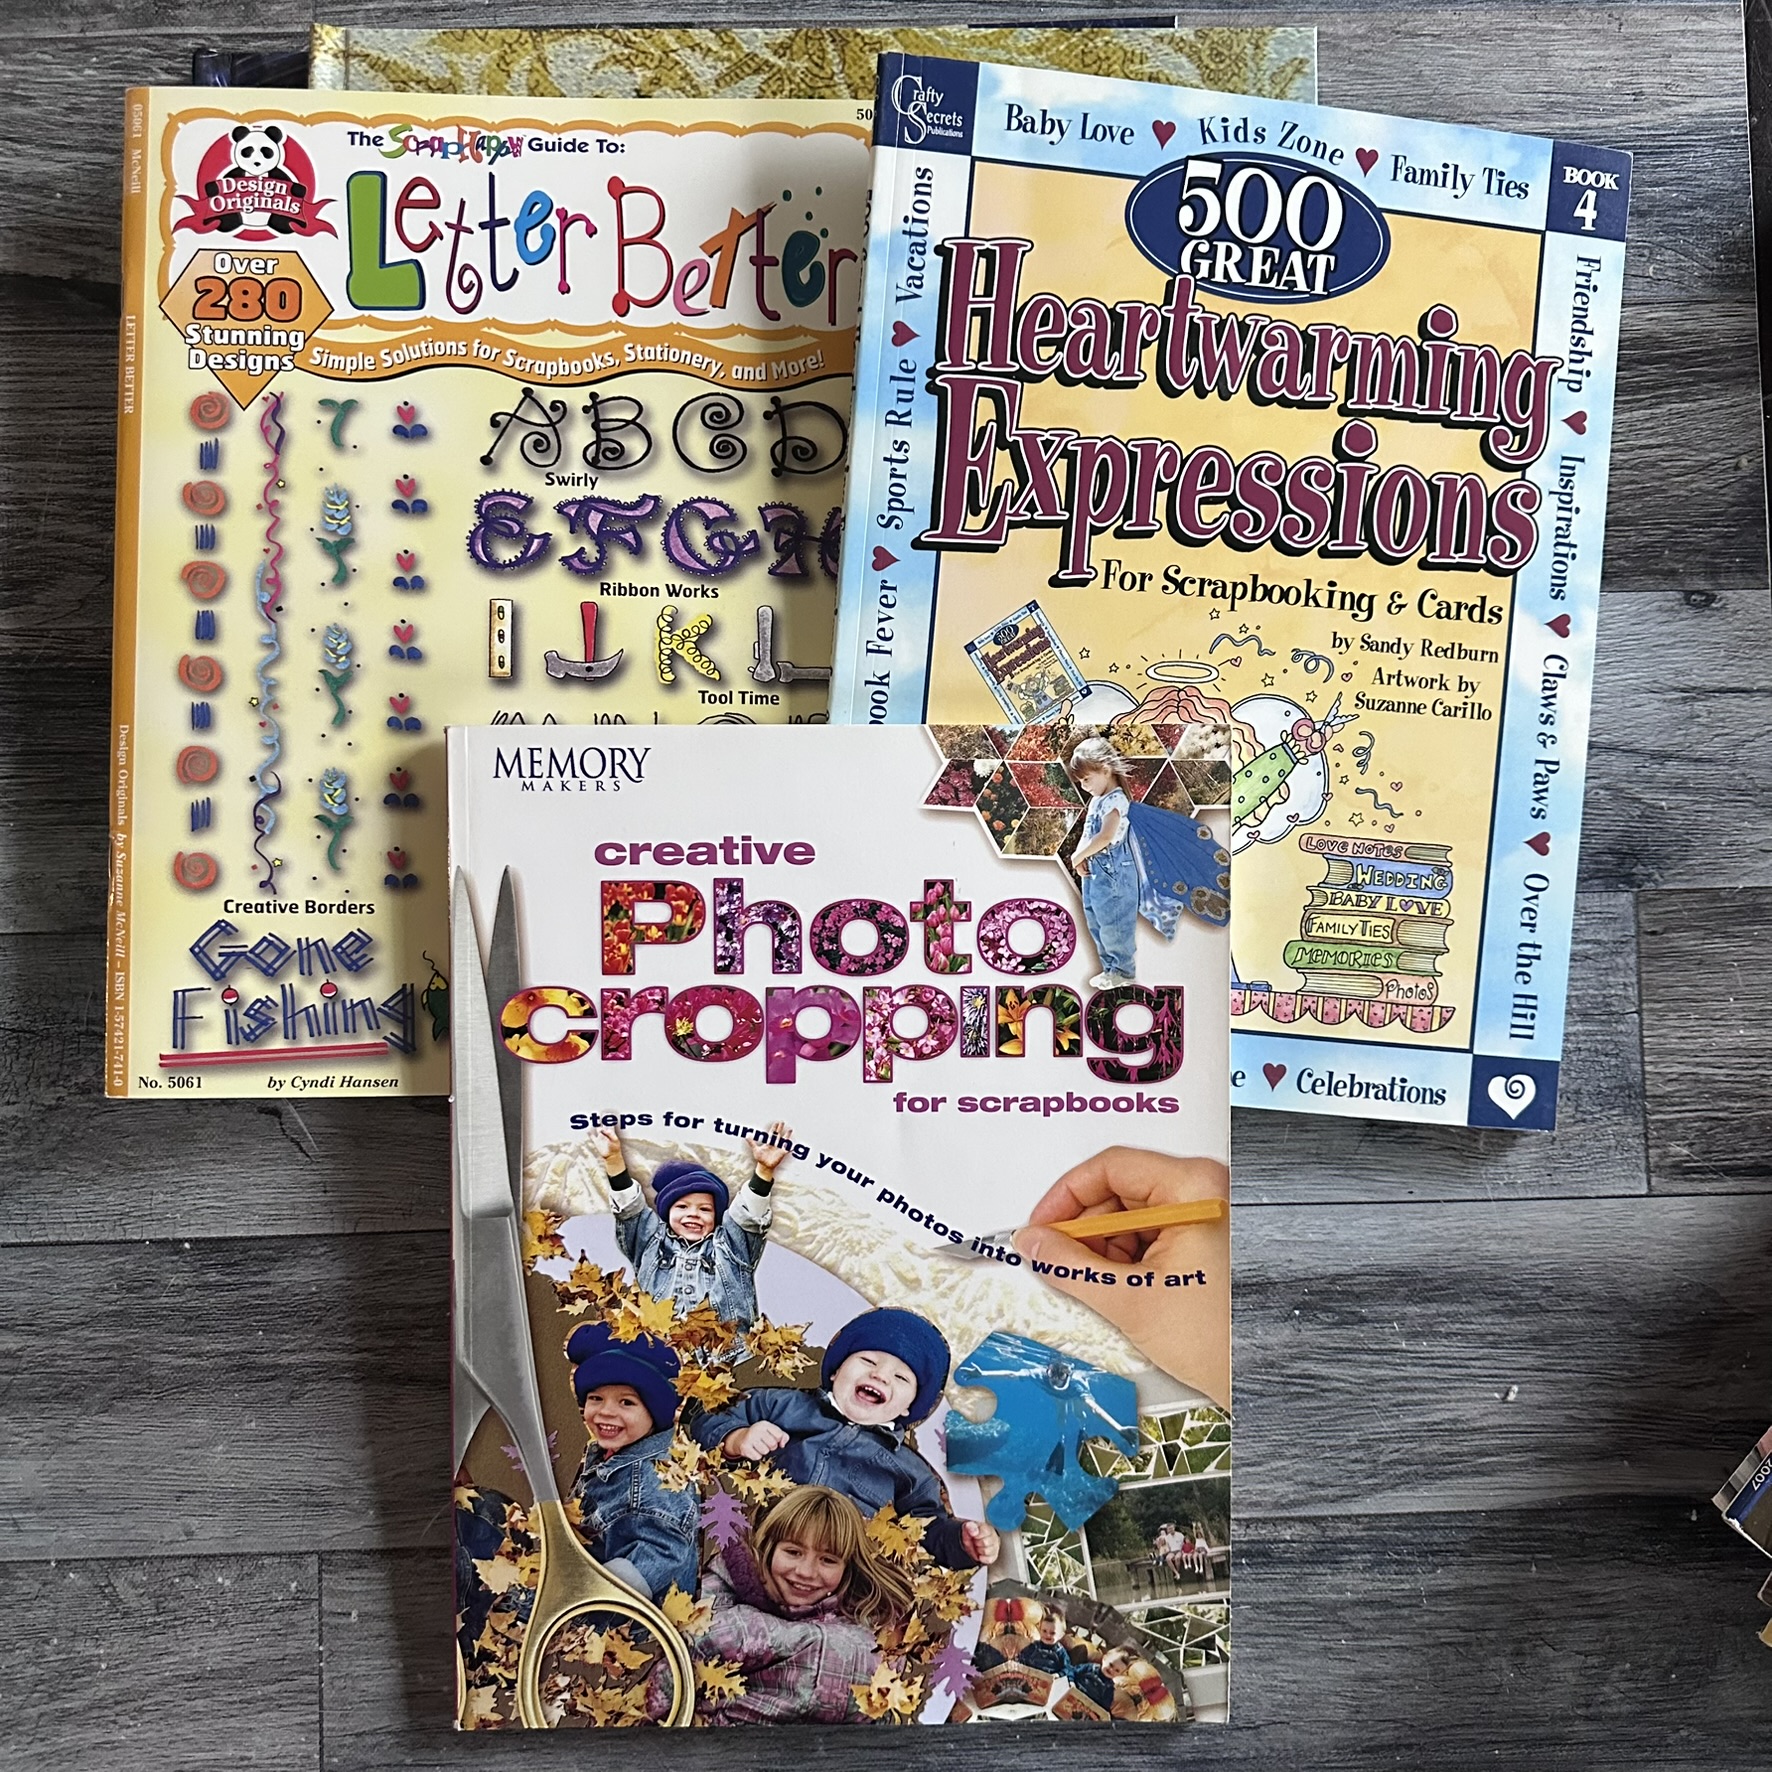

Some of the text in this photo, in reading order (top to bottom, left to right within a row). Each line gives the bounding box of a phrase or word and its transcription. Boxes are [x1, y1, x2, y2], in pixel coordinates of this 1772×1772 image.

[891, 75, 944, 115] Crafty
[904, 101, 963, 144] Secrets
[927, 126, 963, 138] Publications
[130, 104, 143, 194] 05061 McNeill
[347, 131, 384, 147] The
[527, 138, 589, 153] Guide
[595, 138, 626, 154] To:
[1004, 102, 1529, 200] Baby Love Kids Zone Family Ties
[219, 176, 288, 201] Design
[1563, 166, 1619, 191] BOOK
[209, 194, 300, 214] Originals
[1177, 155, 1344, 252] 500
[1573, 189, 1598, 231] 4
[214, 252, 279, 275] Over
[346, 170, 858, 326] Letter Better
[1179, 240, 1335, 295] GREAT
[193, 276, 303, 322] 280
[185, 324, 306, 351] Stunning
[934, 237, 1563, 472] Heartwarming
[124, 315, 136, 414] LETTER BETTER
[188, 349, 296, 375] Designs
[309, 338, 825, 382] Simple Solutions for Scrapbooks, Stationery, and More!
[864, 166, 934, 724] ook Fever Sports Rule Vacations
[544, 473, 599, 490] Swirly
[918, 374, 1541, 588] Expressions
[600, 582, 719, 599] Ribbon Works
[1101, 558, 1503, 626] For Scrapbooking & Cards
[1331, 631, 1499, 664] by Sandy Redburn
[1509, 254, 1601, 1040] Friendship Inspirations Claws & Paws Over the Hill
[698, 690, 780, 706] Tool Time
[1371, 667, 1481, 698] Artwork by
[1355, 692, 1492, 722] Suzanne Carillo
[116, 724, 129, 766] Design
[492, 747, 651, 783] MEMORY
[116, 769, 128, 825] Originals
[520, 780, 621, 792] MAKERS
[115, 833, 127, 847] by
[594, 835, 816, 866] creative
[115, 851, 127, 907] Suzanne
[1355, 864, 1448, 890] WEDDING
[223, 899, 375, 915] Creative Borders
[1328, 891, 1382, 909] BABY
[115, 911, 126, 959] McNeill
[600, 877, 1076, 976] Photo
[1307, 917, 1391, 939] FAMILY TIES
[190, 919, 374, 981] Gone
[115, 971, 125, 1001] ISBN
[172, 979, 416, 1054] Fishing
[499, 984, 1185, 1084] cropping
[113, 1005, 124, 1086] 1-57421-741-0
[138, 1076, 202, 1089] No. 5061
[267, 1076, 398, 1091] by Cyndi Hansen
[1296, 1068, 1447, 1105] Celebrations
[894, 1091, 1179, 1117] for scrapbooks
[662, 1111, 704, 1129] for
[713, 1117, 810, 1161] turning
[816, 1151, 875, 1189] your
[876, 1186, 964, 1245] photos
[970, 1235, 1021, 1266] into
[1031, 1259, 1116, 1285] works
[1126, 1271, 1155, 1287] of
[1164, 1269, 1207, 1286] art
